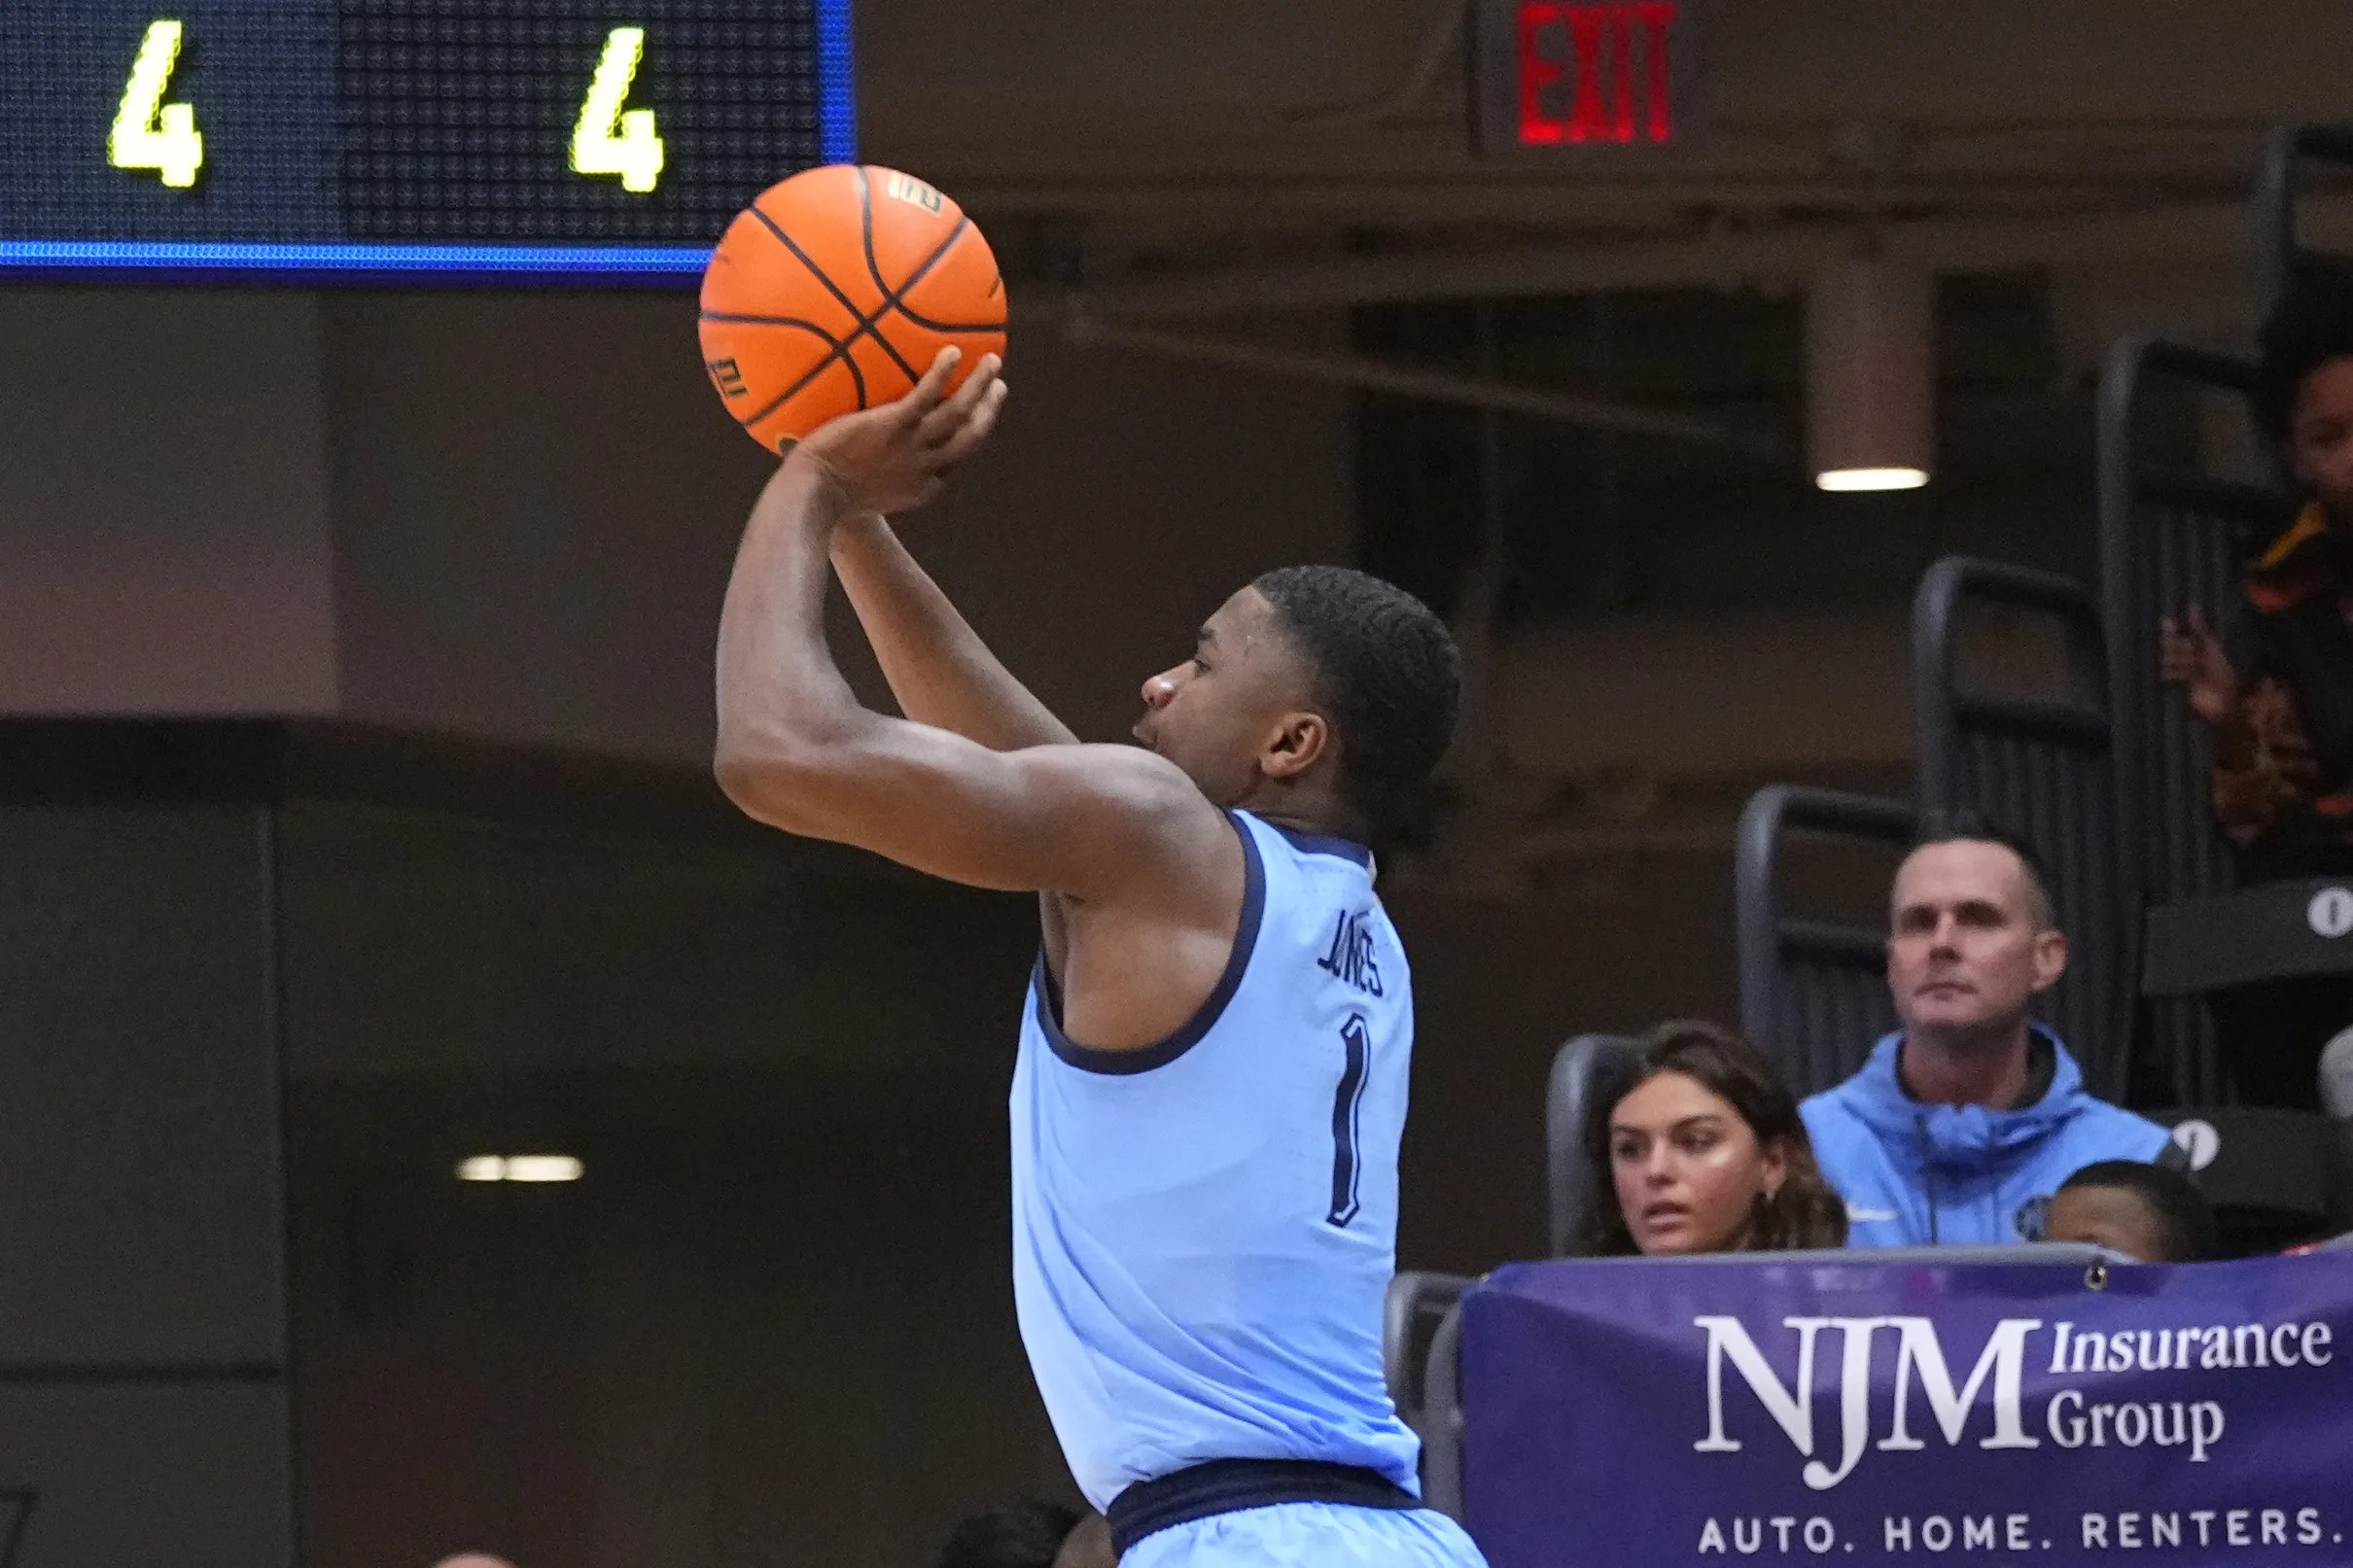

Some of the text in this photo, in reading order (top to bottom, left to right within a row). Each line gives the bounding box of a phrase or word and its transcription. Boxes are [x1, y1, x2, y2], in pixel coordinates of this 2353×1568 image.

[107, 19, 202, 187] 4
[569, 27, 663, 192] 4
[1519, 2, 1674, 144] EXIT
[1326, 1013, 1370, 1228] 1
[1694, 1315, 2043, 1490] NJM
[2048, 1320, 2333, 1374] Insurance
[2047, 1390, 2225, 1462] Group
[1698, 1508, 2342, 1554] AUTO. HOME. RENTERS.
